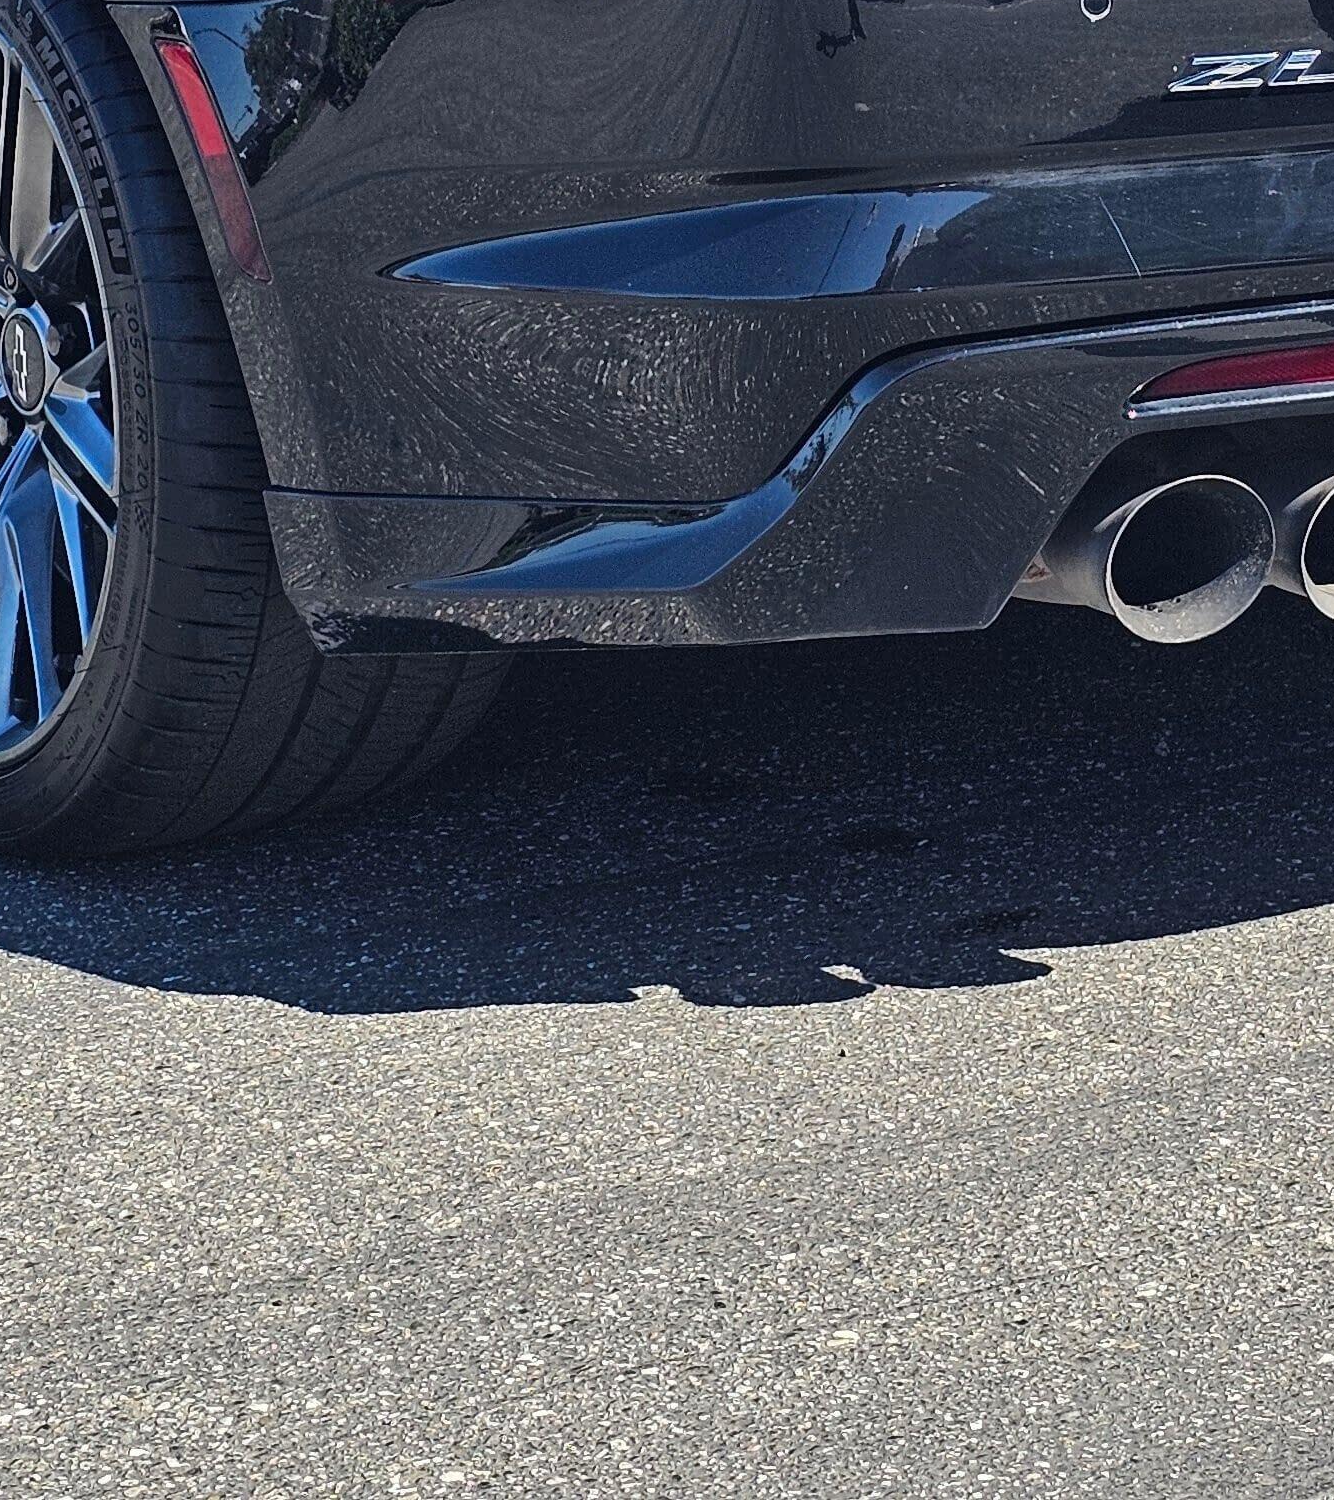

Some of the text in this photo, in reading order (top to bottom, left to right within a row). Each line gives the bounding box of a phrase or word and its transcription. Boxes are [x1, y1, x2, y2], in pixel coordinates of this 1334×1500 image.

[36, 34, 127, 258] MICHELIN
[125, 301, 146, 399] 305/30
[135, 409, 148, 446] ZR
[137, 455, 149, 490] 20
